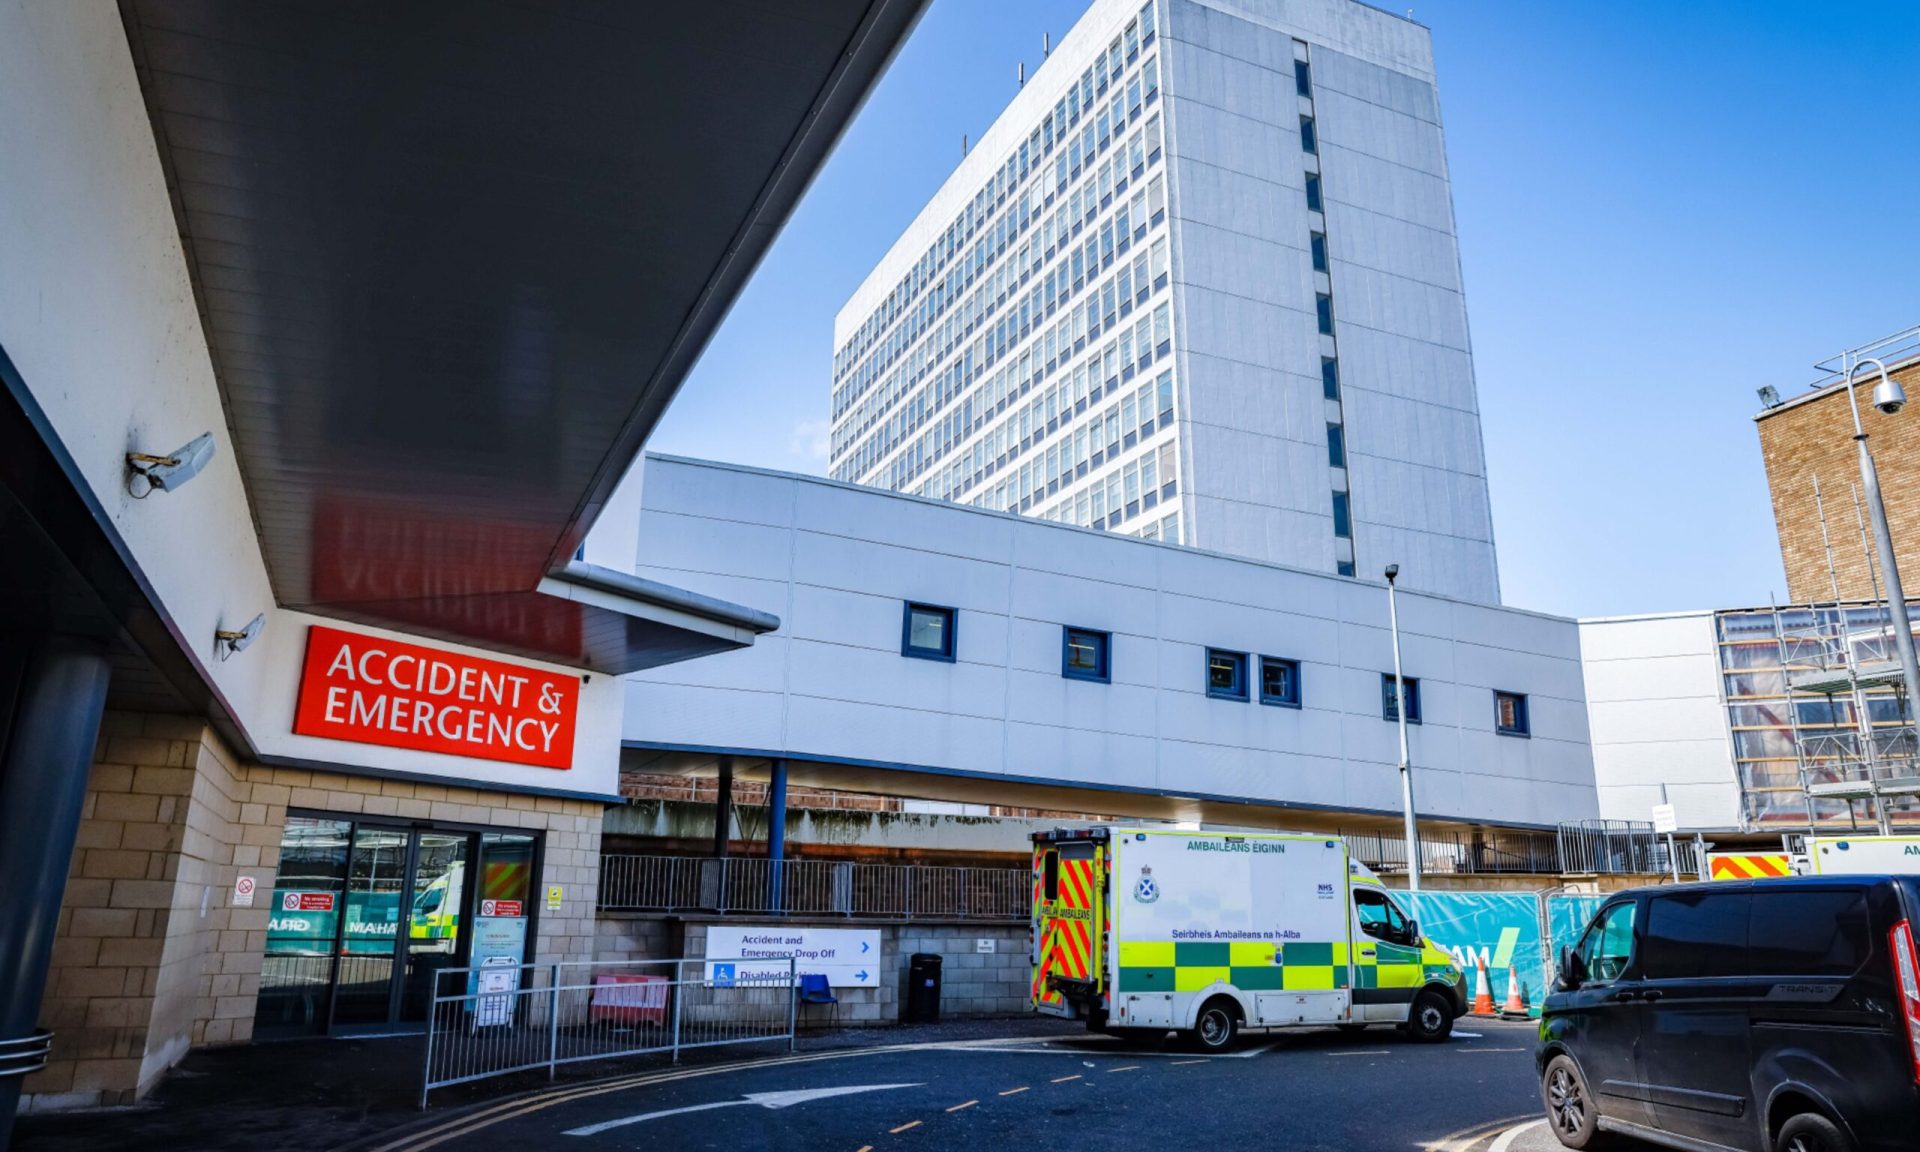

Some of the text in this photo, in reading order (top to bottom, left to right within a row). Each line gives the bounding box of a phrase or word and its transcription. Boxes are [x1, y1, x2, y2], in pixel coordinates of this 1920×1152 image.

[327, 644, 563, 715] ACCIDENT &
[325, 687, 559, 752] EMERGENCY
[1187, 841, 1250, 853] AMBAILEANS
[1318, 883, 1333, 891] NHS
[1172, 929, 1212, 939] Seirbheis
[1214, 929, 1261, 939] Ambaileans
[1275, 929, 1300, 939] h-Alba
[742, 935, 803, 945] Accident and
[741, 948, 836, 959] Emergency Drop Off
[741, 971, 782, 980] Disabled
[1778, 984, 1837, 993] TRANSIT
